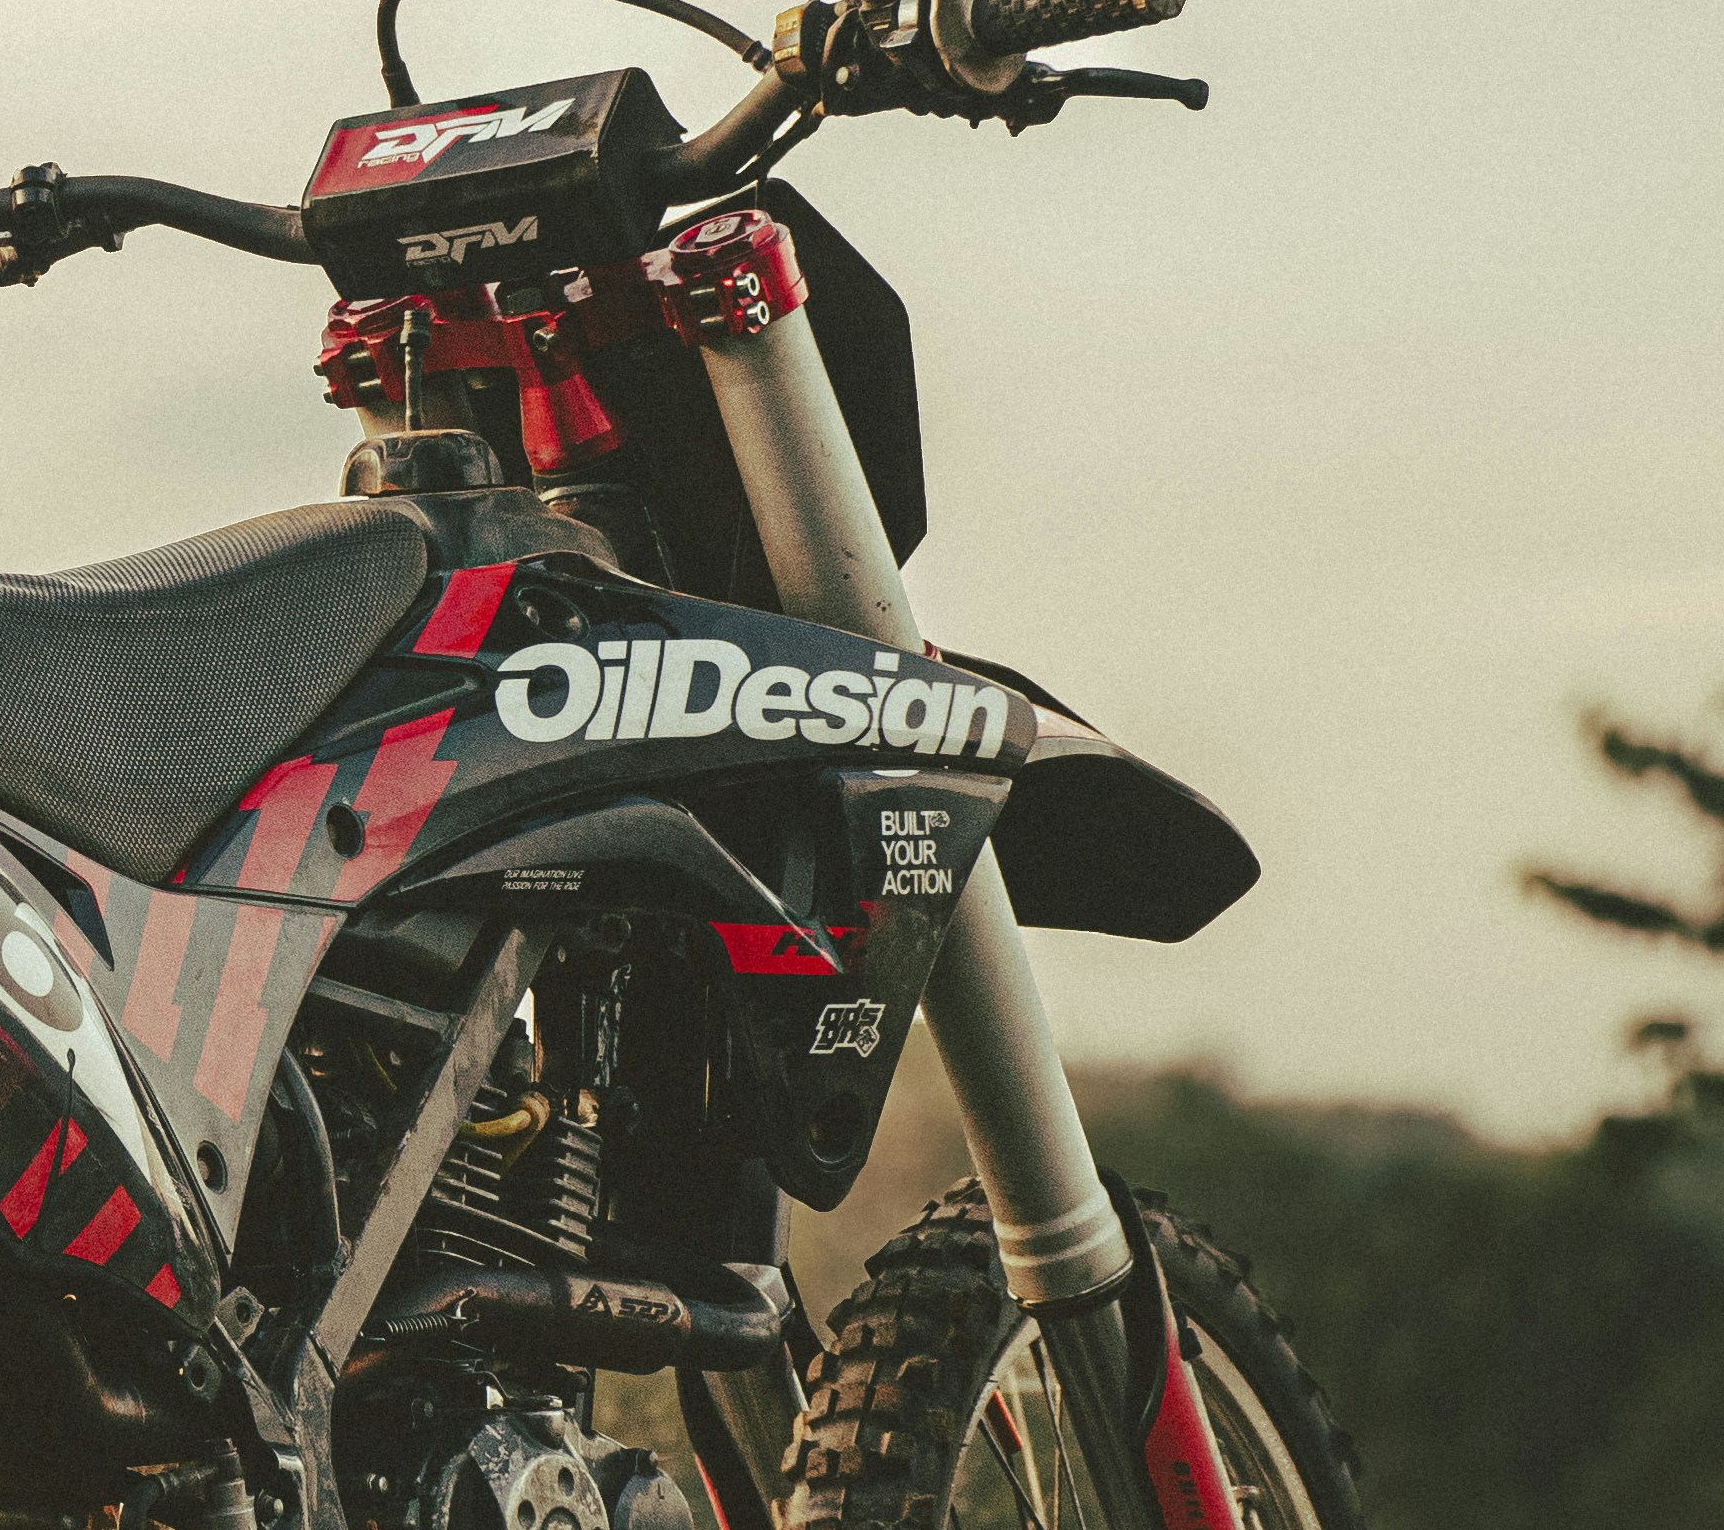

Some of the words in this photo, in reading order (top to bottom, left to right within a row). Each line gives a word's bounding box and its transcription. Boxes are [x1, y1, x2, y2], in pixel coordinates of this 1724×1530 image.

[361, 98, 576, 164] DFM
[357, 152, 421, 169] racing
[397, 216, 538, 265] DFM
[495, 638, 1009, 777] OilDesign
[880, 810, 935, 836] BUILT
[880, 839, 937, 866] YOUR
[881, 868, 953, 896] ACTION
